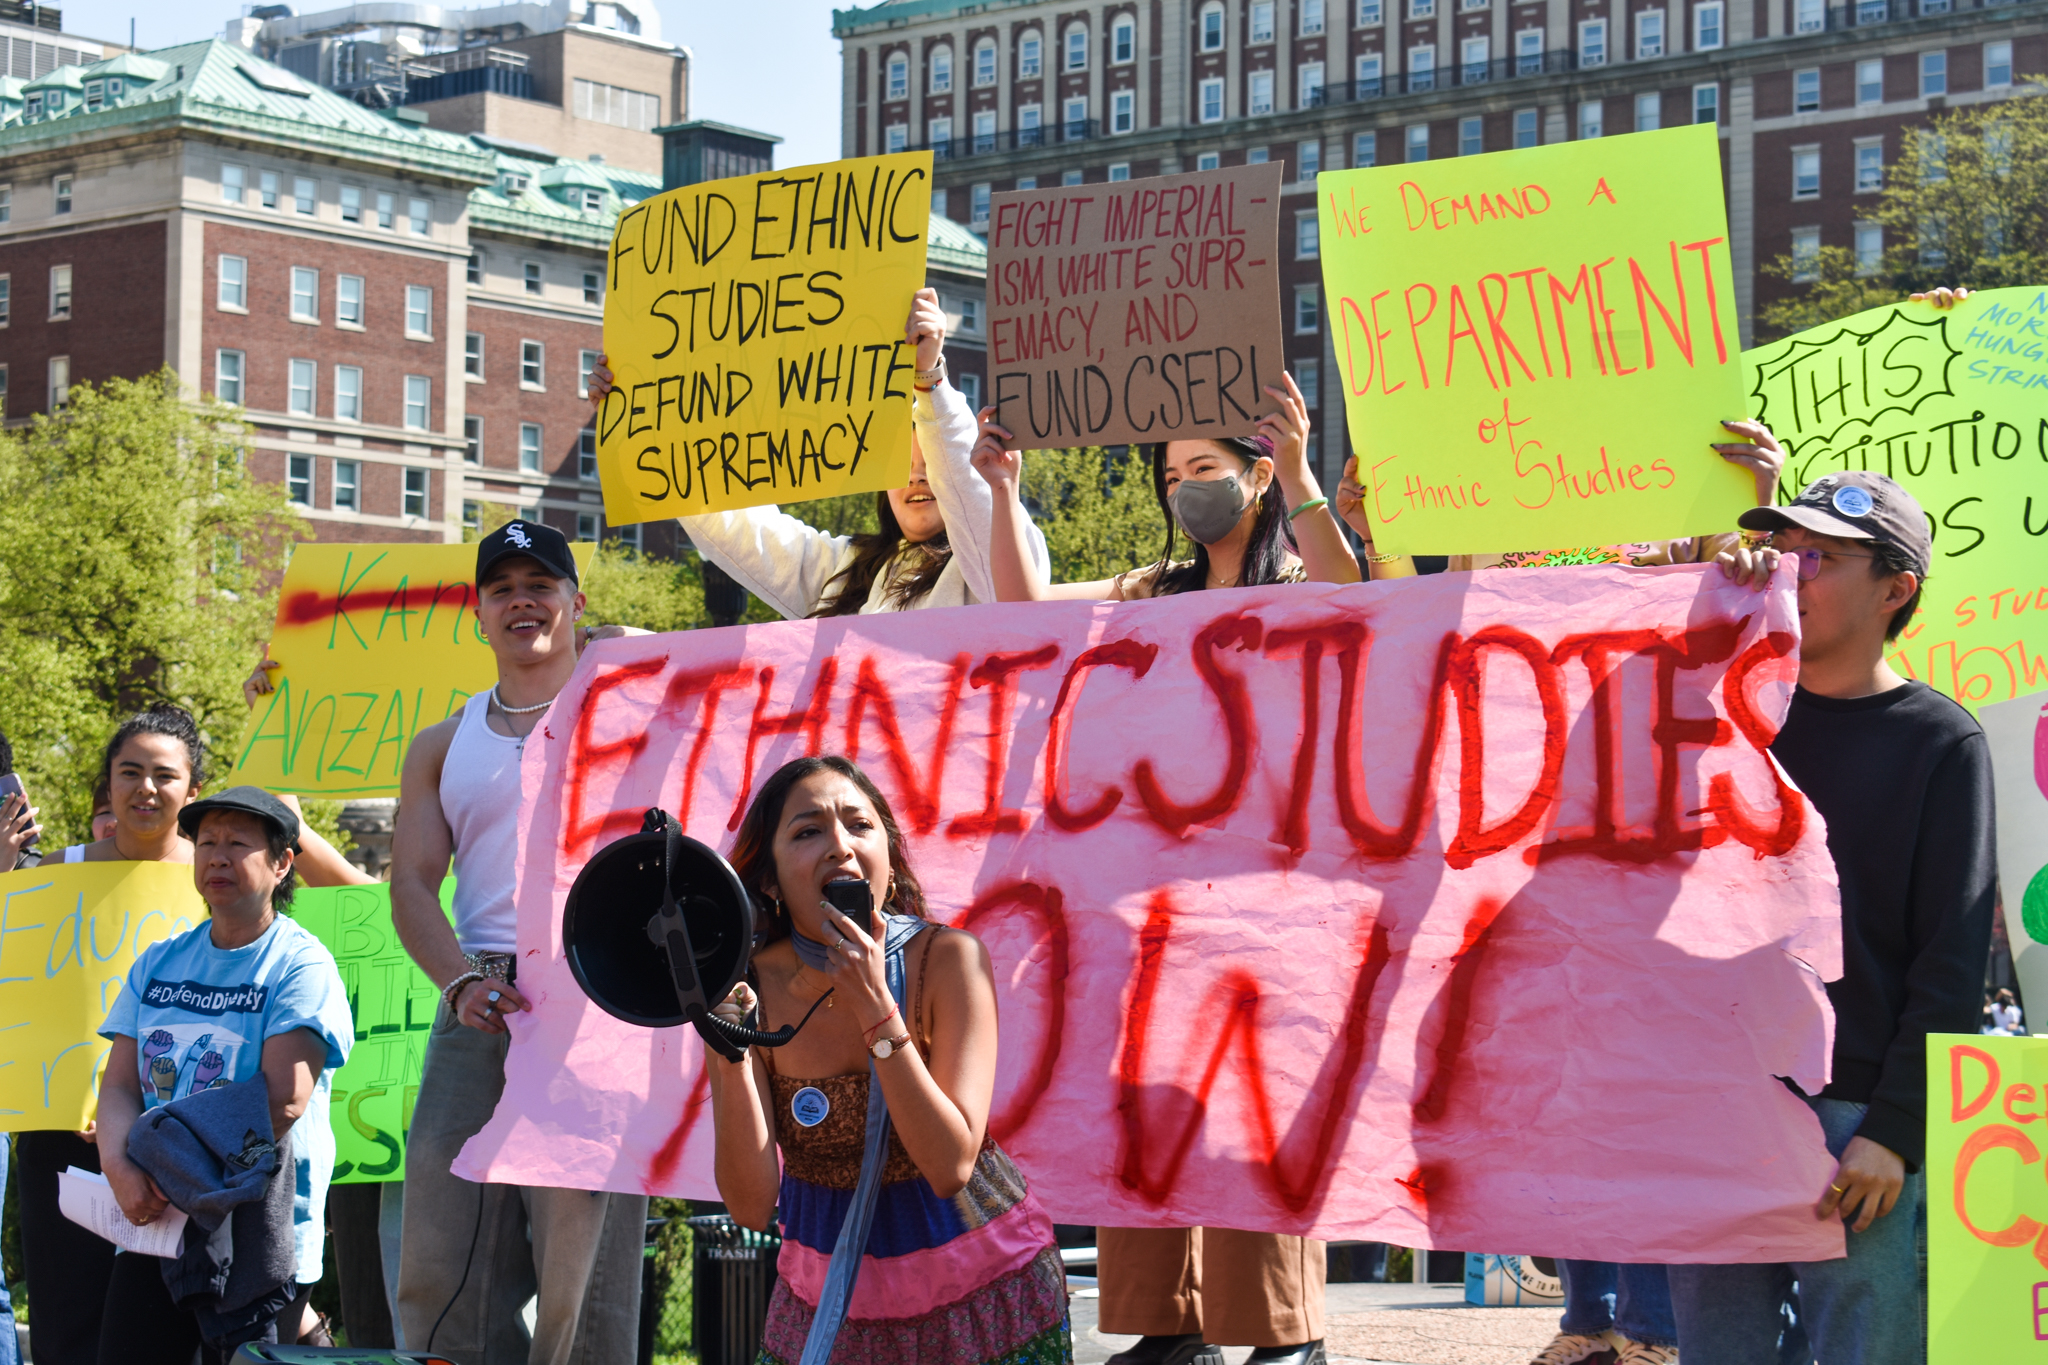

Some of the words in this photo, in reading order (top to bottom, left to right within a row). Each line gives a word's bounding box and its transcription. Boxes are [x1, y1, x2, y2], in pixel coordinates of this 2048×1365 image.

[613, 193, 736, 291] FUND
[751, 165, 925, 261] ETHNIC
[994, 197, 1094, 248] FIGHT
[1398, 180, 1551, 232] DEMAND
[1587, 176, 1617, 206] A
[650, 270, 844, 360] STUDIES
[994, 255, 1050, 308] ISM,
[1057, 245, 1157, 298] WHITE
[993, 300, 1105, 365] EMACY,
[1124, 292, 1199, 348] AND
[1340, 236, 1728, 398] DEPARTMENT
[1964, 326, 2048, 364] HUNG
[1976, 302, 2048, 341] MOR
[600, 363, 753, 448] DEFUND
[778, 340, 914, 409] WHITE
[996, 364, 1113, 440] FUND
[1124, 344, 1262, 432] CSER!
[1768, 334, 1929, 434] THIS
[636, 410, 874, 506] SUPREMACY
[1477, 397, 1532, 455] of
[1371, 455, 1491, 523] Ethnic
[1513, 440, 1676, 510] Studies
[564, 636, 1158, 860] ETHNIC
[1133, 610, 1806, 870] STUDIES
[706, 1247, 758, 1260] TRASH
[1507, 1256, 1535, 1285] ELCOME
